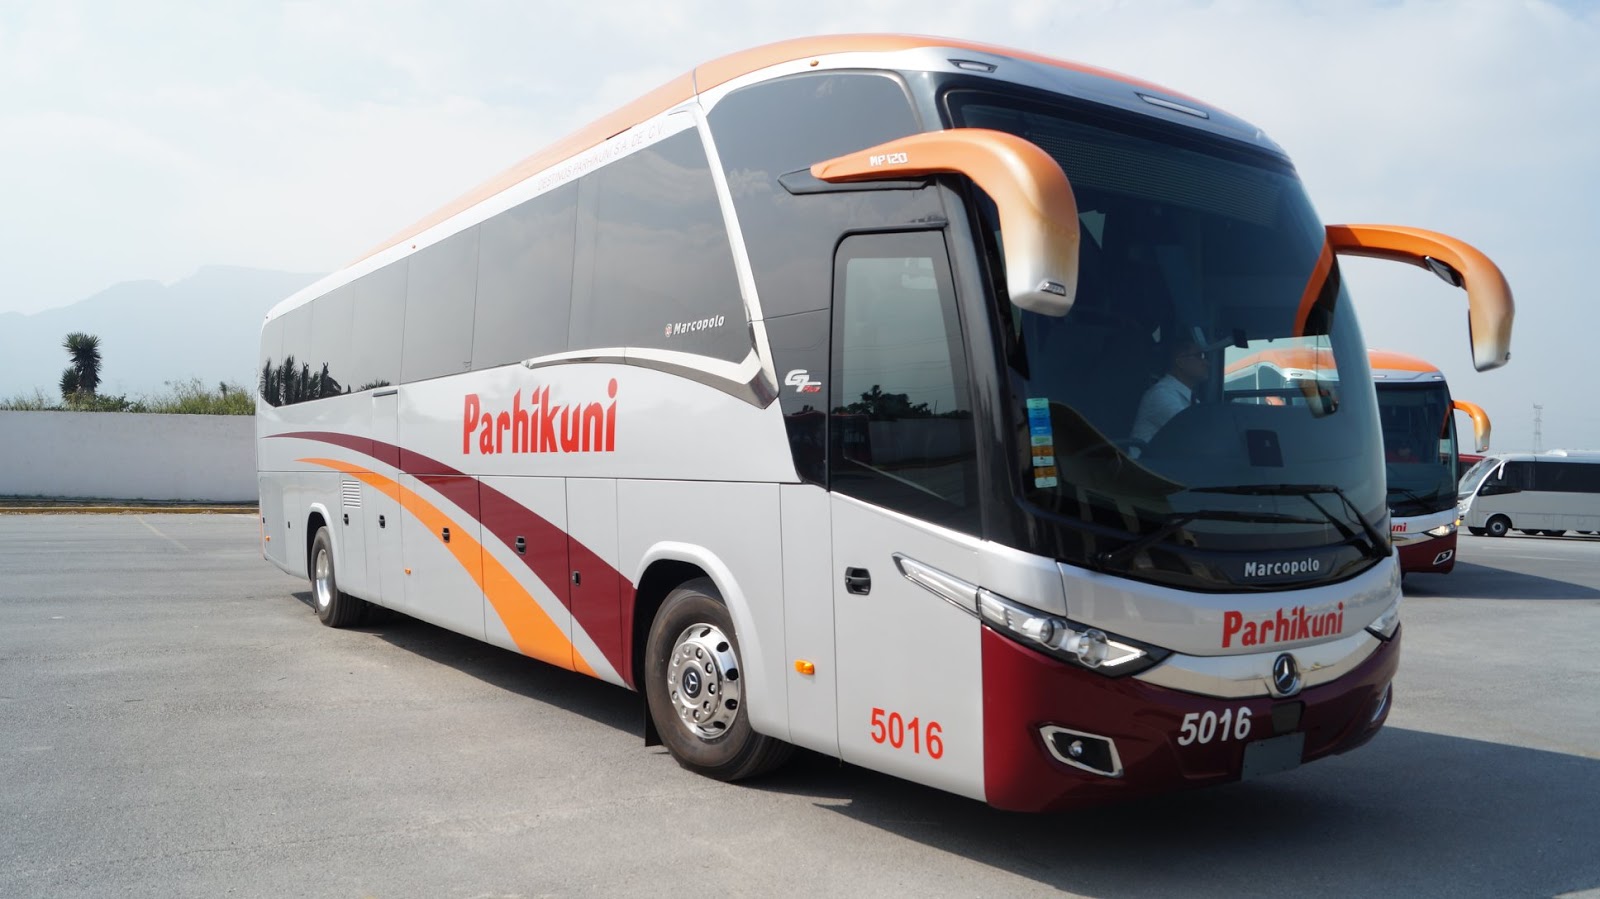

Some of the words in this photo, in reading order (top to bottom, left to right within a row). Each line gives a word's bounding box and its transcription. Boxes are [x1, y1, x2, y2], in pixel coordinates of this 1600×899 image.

[673, 315, 725, 335] Marcopolo
[463, 378, 618, 455] Parhikuni
[1244, 558, 1320, 577] Marcopolo
[1222, 601, 1343, 648] Parhikuni
[871, 707, 944, 760] 5016
[1177, 706, 1252, 746] 5016
